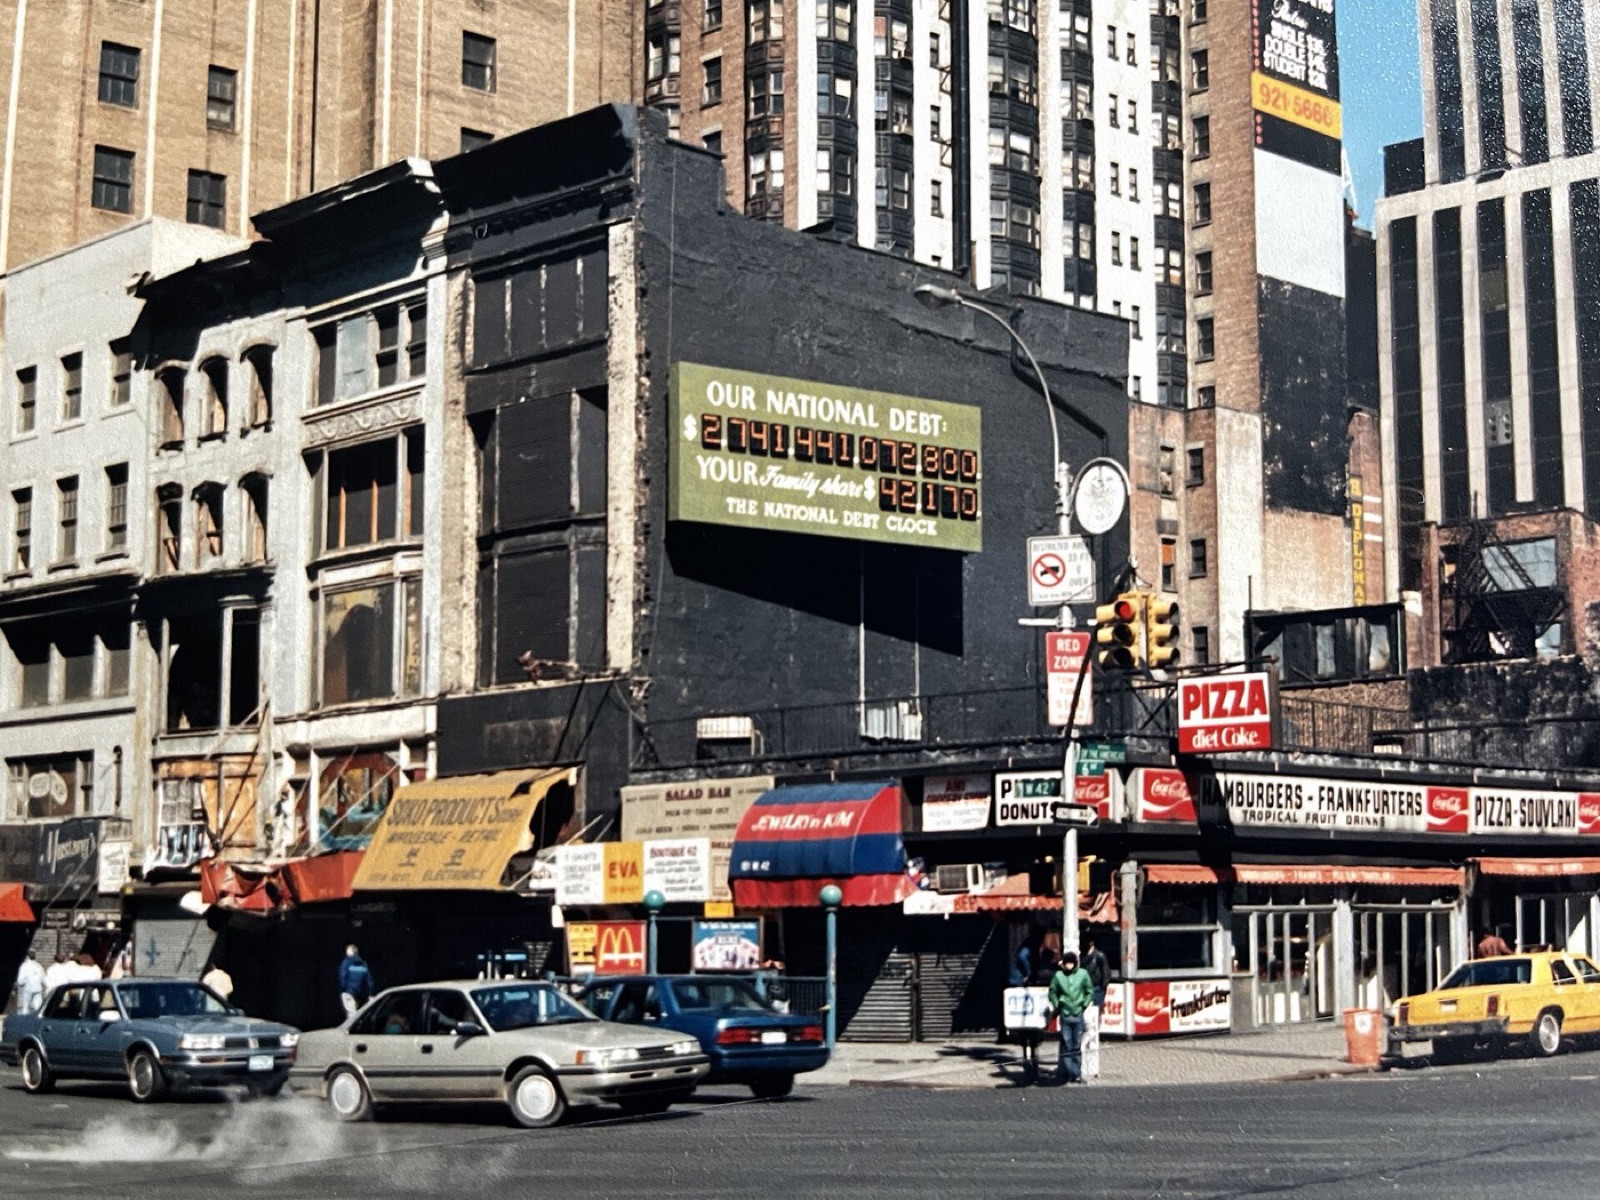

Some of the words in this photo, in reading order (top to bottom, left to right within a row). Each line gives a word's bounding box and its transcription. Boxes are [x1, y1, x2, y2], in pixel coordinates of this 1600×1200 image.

[1265, 34, 1305, 63] DOUBLE
[1263, 50, 1305, 81] STUDENT
[706, 380, 756, 411] OUR
[766, 389, 879, 429] NATIONAL
[889, 408, 947, 437] DEBT:
[696, 455, 758, 486] YOUR
[759, 465, 821, 499] Family
[819, 473, 864, 498] share
[726, 497, 759, 515] THE
[764, 501, 839, 524] NATIONAL
[843, 510, 880, 529] DEBT
[886, 515, 937, 536] CLOCK
[1056, 638, 1080, 653] RED
[1182, 679, 1268, 721] PIZZA
[1192, 729, 1220, 748] diet
[1221, 727, 1260, 747] Coke
[665, 787, 703, 801] SALAD
[708, 787, 732, 799] BAR
[1035, 782, 1049, 795] 42
[1318, 785, 1423, 816] FRANKFURTERS
[1242, 809, 1298, 823] TROPICAL
[1305, 812, 1337, 825] FRUIT
[608, 861, 639, 879] EVA
